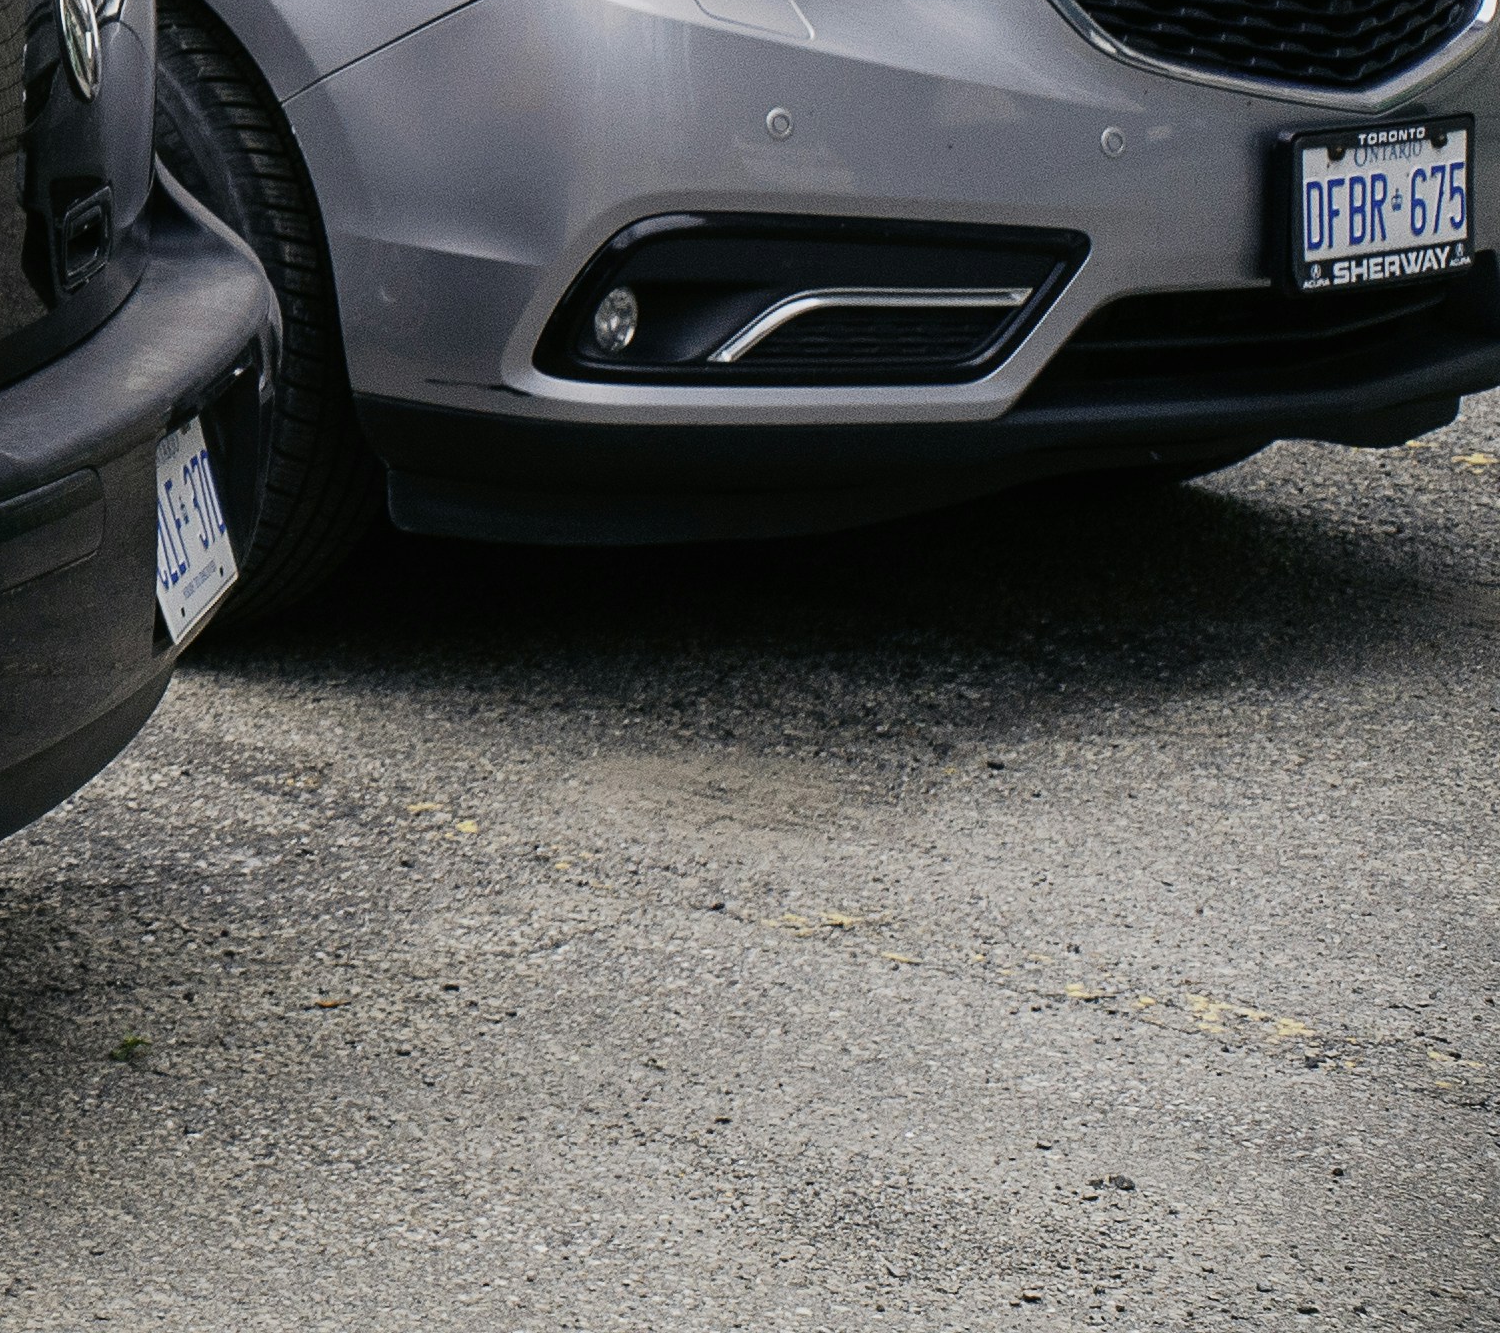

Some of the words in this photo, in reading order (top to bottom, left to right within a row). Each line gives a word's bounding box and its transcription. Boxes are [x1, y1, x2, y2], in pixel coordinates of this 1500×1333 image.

[1358, 126, 1426, 146] TORONTO
[1306, 172, 1388, 251] DFBR
[1411, 161, 1466, 237] 675
[1333, 245, 1450, 286] SHERWAY
